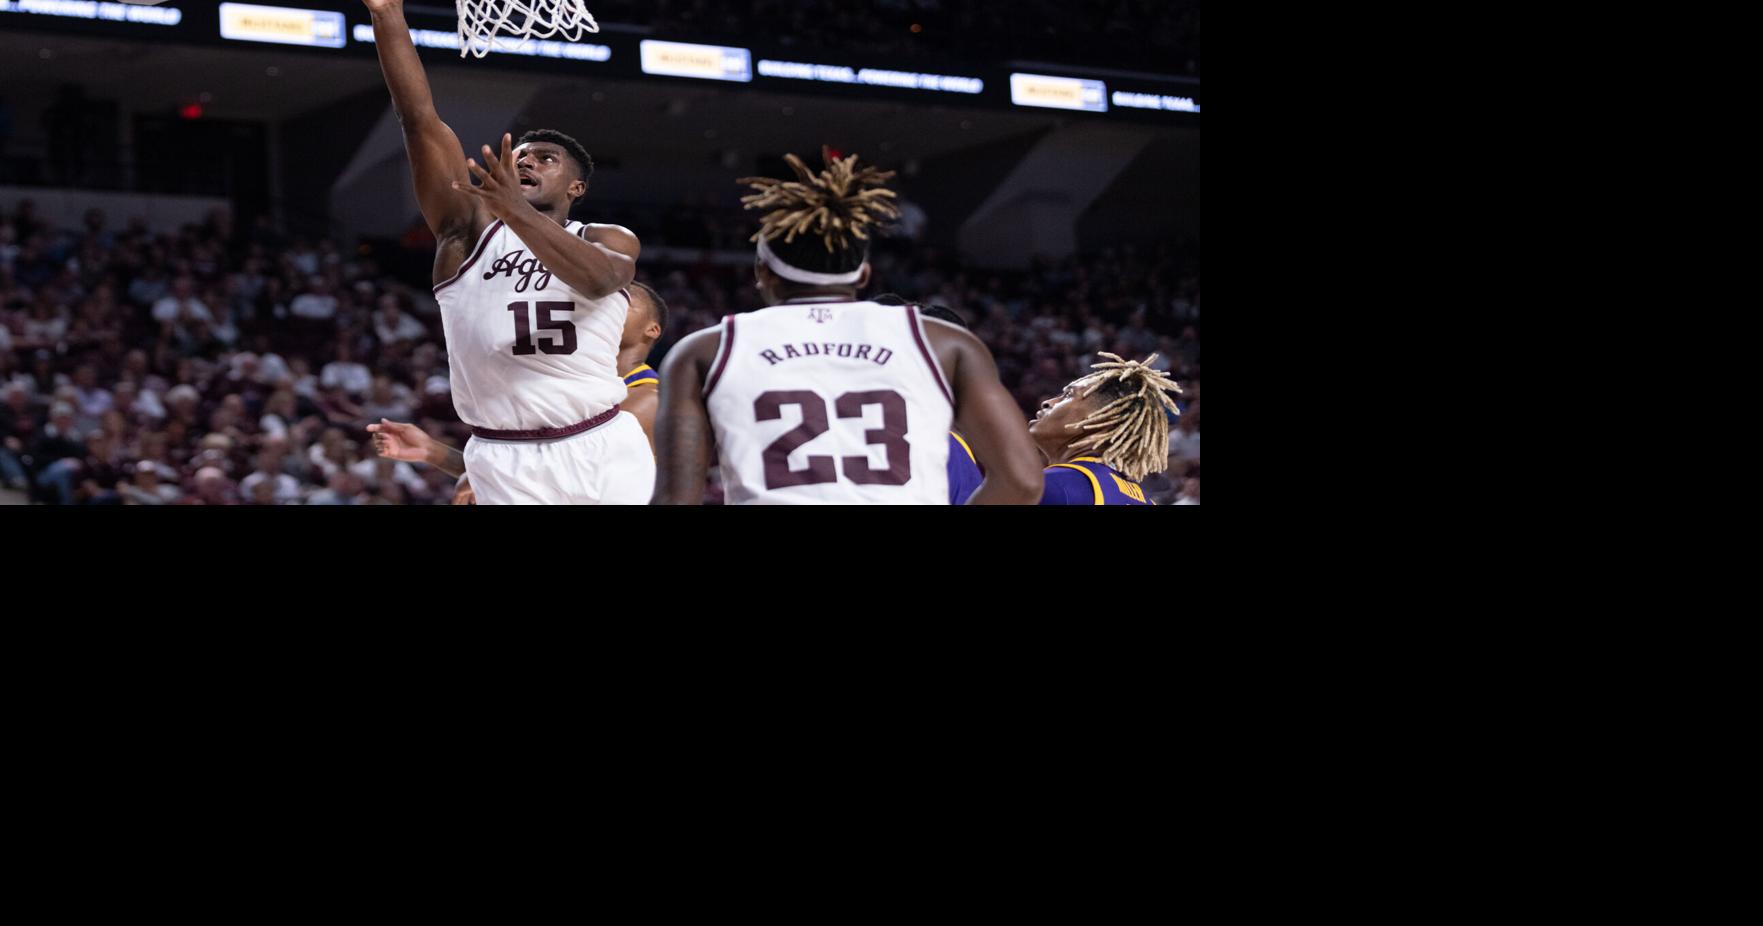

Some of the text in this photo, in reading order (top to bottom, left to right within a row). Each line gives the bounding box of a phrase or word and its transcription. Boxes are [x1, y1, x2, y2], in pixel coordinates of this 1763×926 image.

[507, 301, 578, 355] 15
[760, 342, 893, 366] RADFORD
[753, 389, 911, 490] 23
